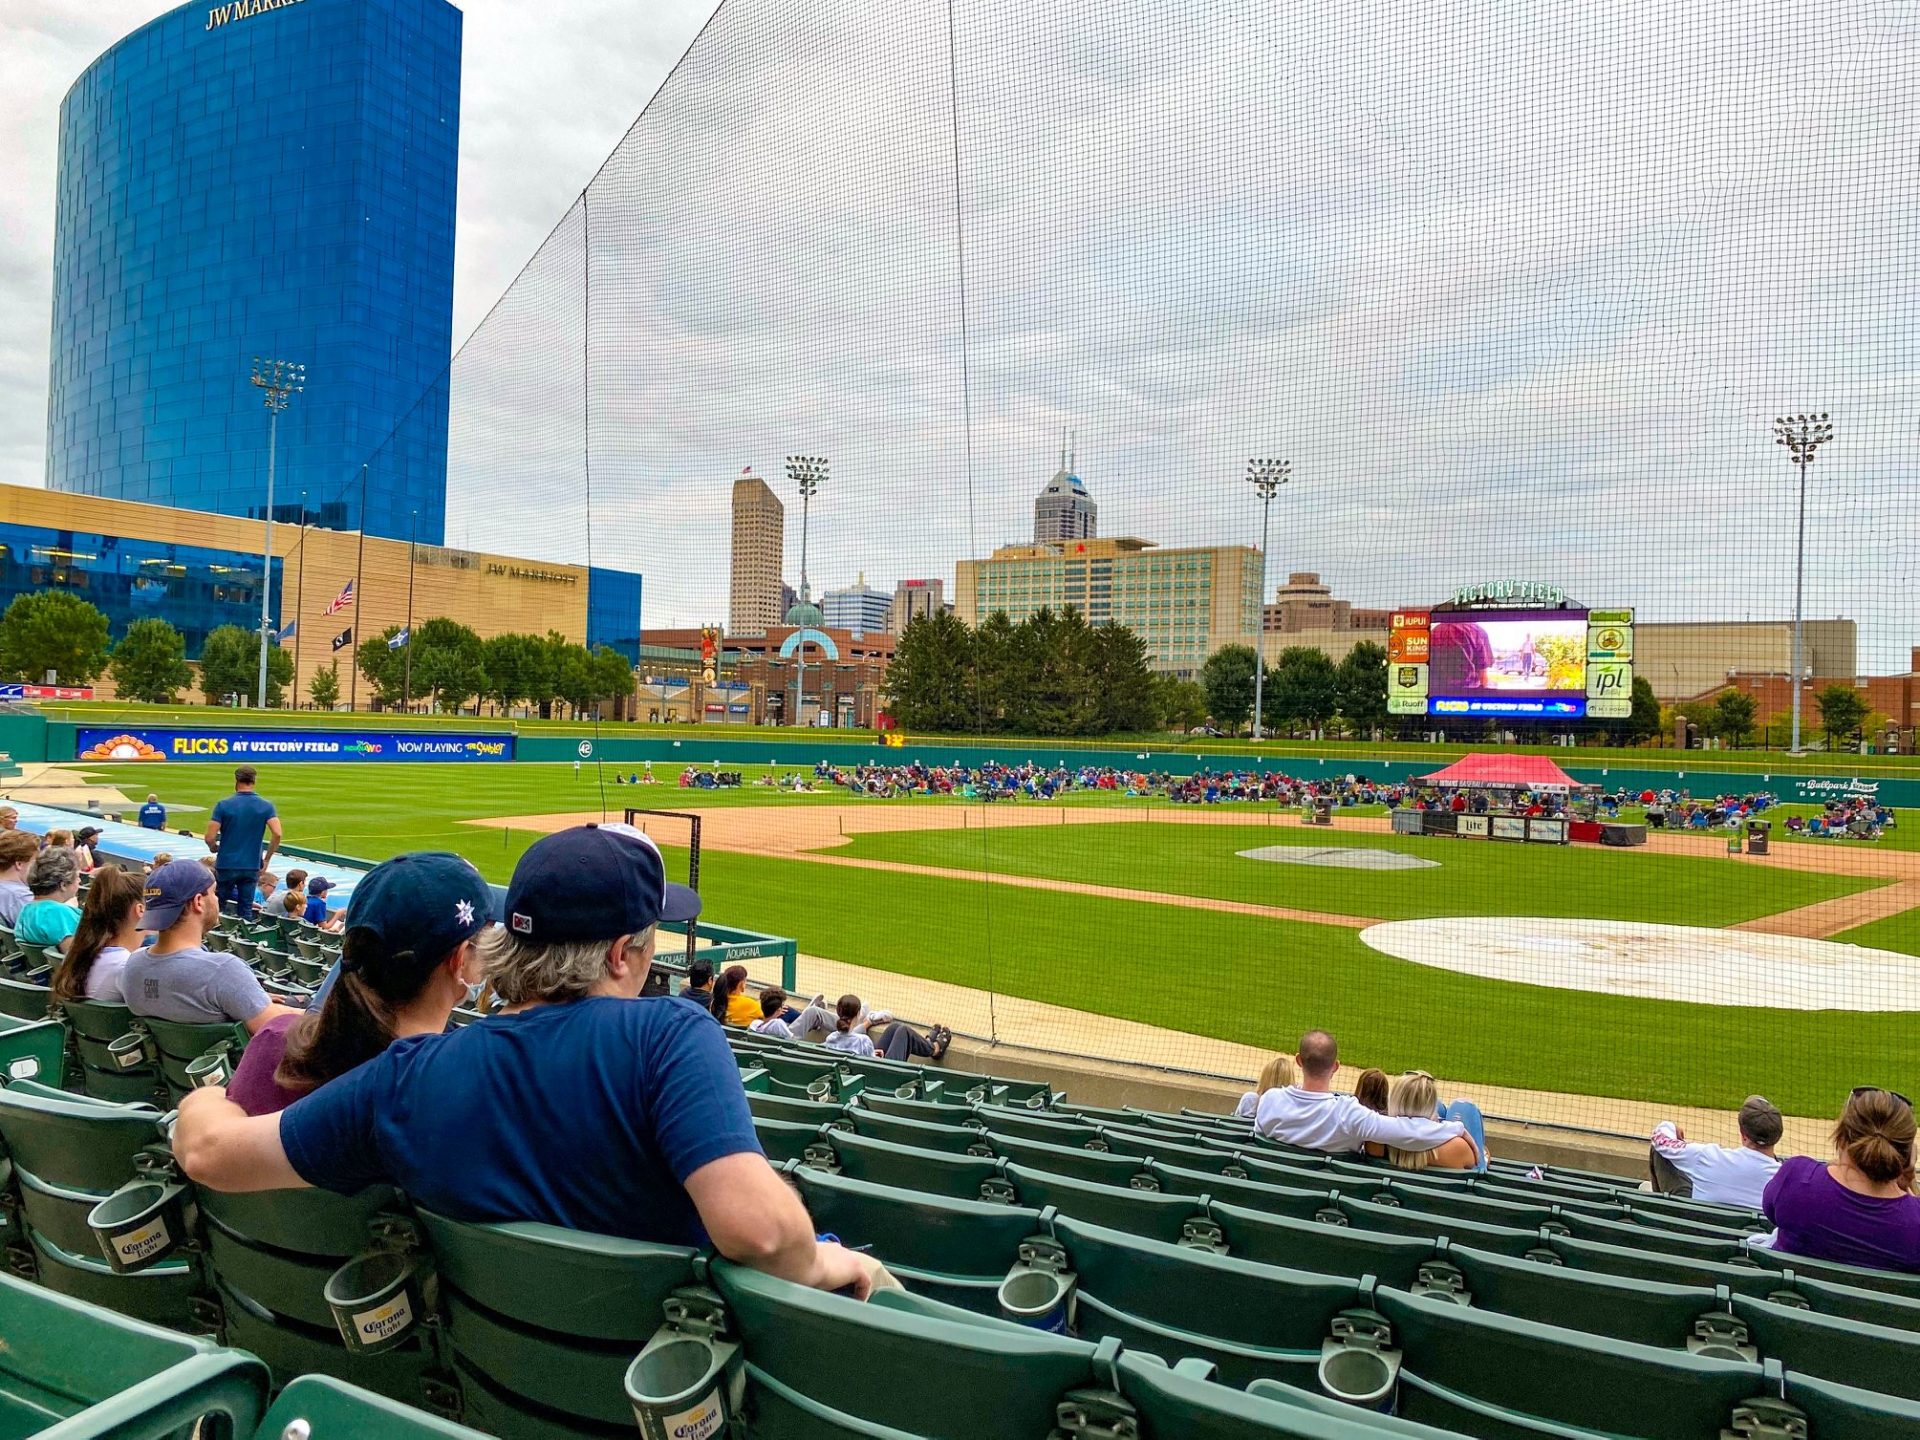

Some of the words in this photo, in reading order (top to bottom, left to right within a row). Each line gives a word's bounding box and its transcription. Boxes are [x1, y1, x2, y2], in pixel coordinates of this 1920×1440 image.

[205, 3, 232, 31] JW
[486, 563, 507, 576] JW
[509, 566, 579, 584] MARRIOTT
[1454, 579, 1517, 606] VICTORY
[1520, 580, 1565, 603] FIELD
[1404, 617, 1427, 626] IUPUI
[1406, 636, 1428, 645] SUN
[1595, 667, 1624, 696] ipl
[1401, 700, 1425, 708] Ruoff
[173, 737, 229, 755] FLICKS
[232, 741, 249, 752] AT
[250, 741, 303, 752] VICTORY
[304, 742, 339, 752] FIELD
[397, 742, 423, 753] NOW
[424, 742, 464, 753] PLAYING
[465, 742, 477, 751] THE
[476, 741, 506, 756] SANDLOT
[579, 743, 592, 754] 42
[1459, 780, 1484, 788] BASEBALL
[1806, 779, 1849, 791] Ballpark
[1465, 820, 1483, 832] Lite
[660, 953, 687, 964] AQUAFI
[725, 945, 761, 961] AQUAFINA
[20, 1063, 28, 1075] L
[121, 1231, 162, 1255] Corona
[137, 1243, 158, 1258] Light
[363, 1307, 406, 1334] Corona
[379, 1320, 401, 1337] Light
[673, 1408, 717, 1439] Corona
